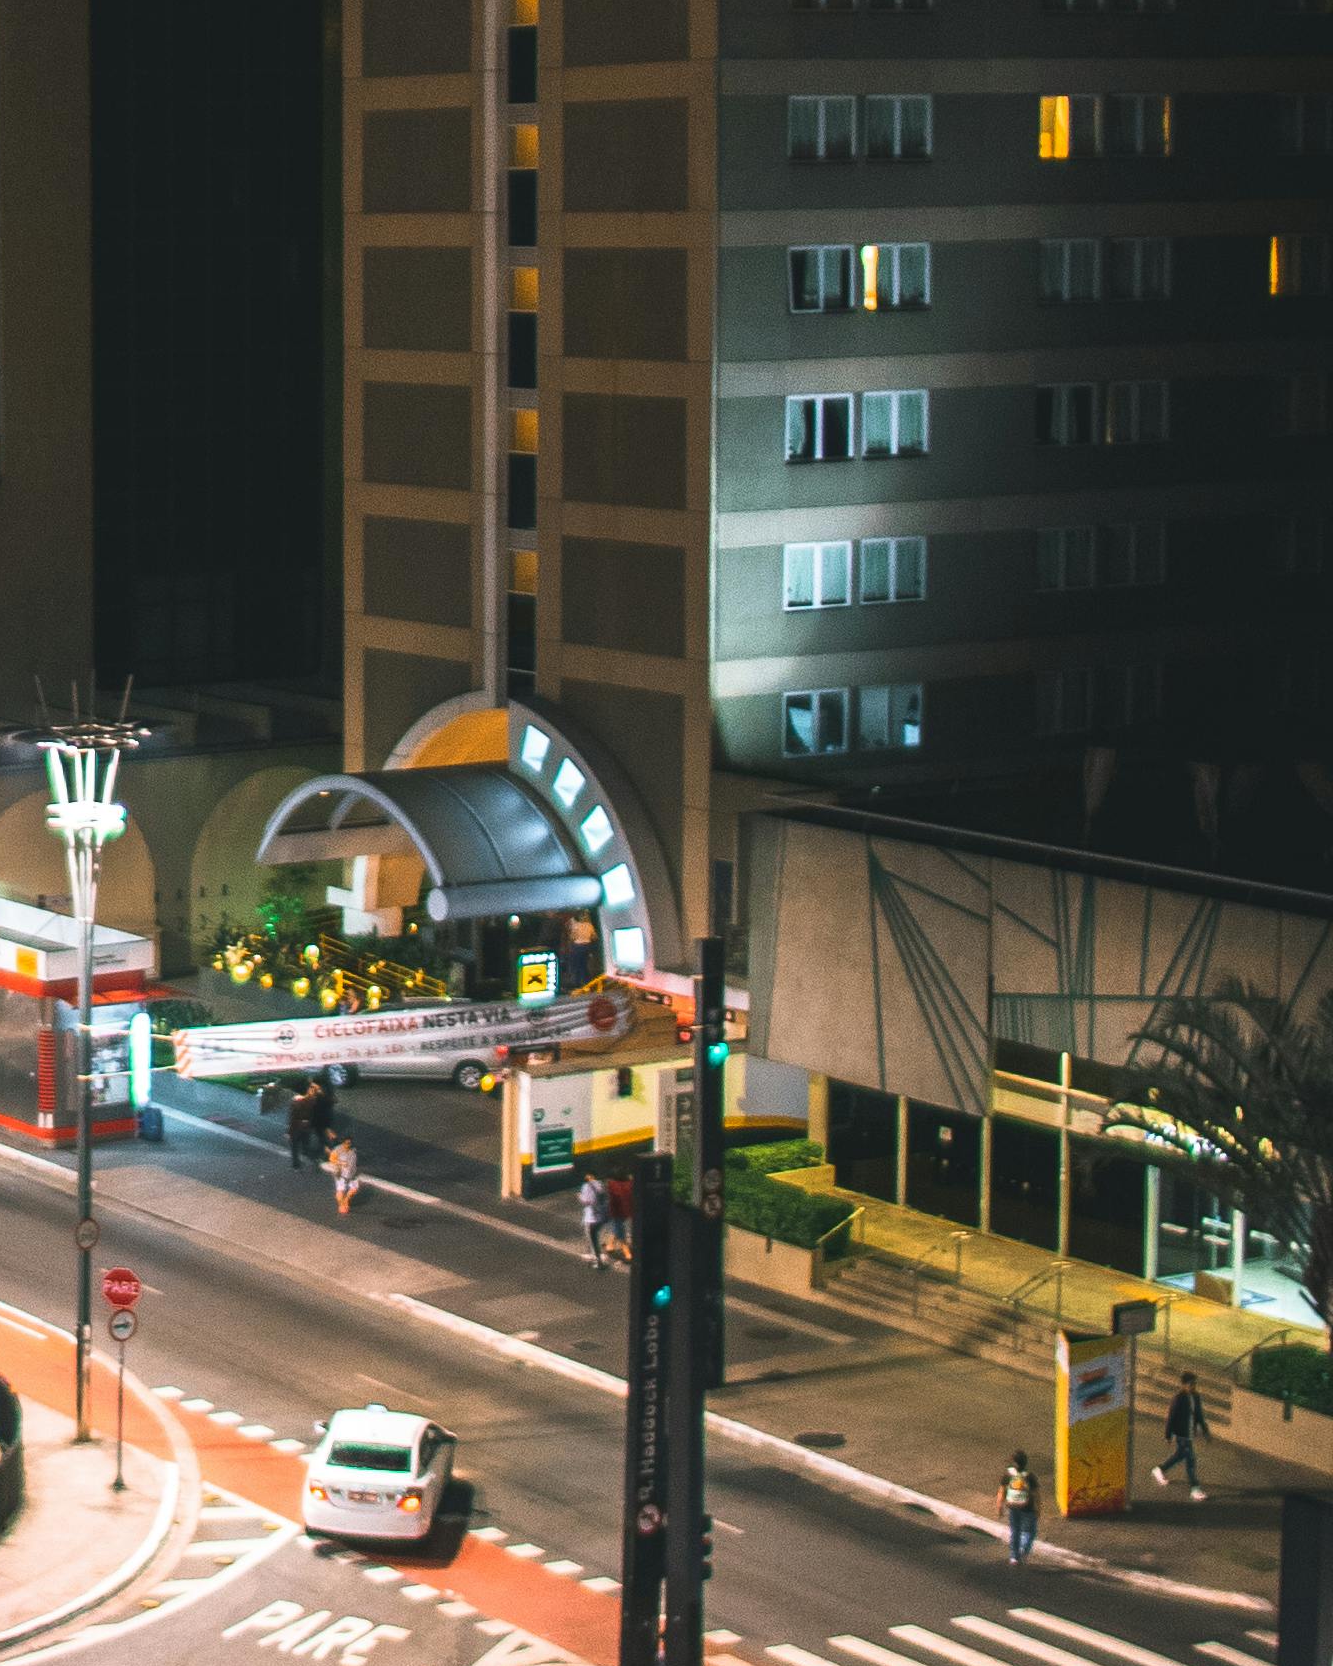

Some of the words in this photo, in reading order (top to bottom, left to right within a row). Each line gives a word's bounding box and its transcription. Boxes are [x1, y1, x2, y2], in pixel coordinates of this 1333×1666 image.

[314, 1016, 419, 1039] CICLOFAIXA
[422, 1009, 479, 1029] NESTA
[485, 1007, 511, 1023] VIA
[644, 1314, 661, 1369] Lobo
[640, 1377, 659, 1474] Haddock
